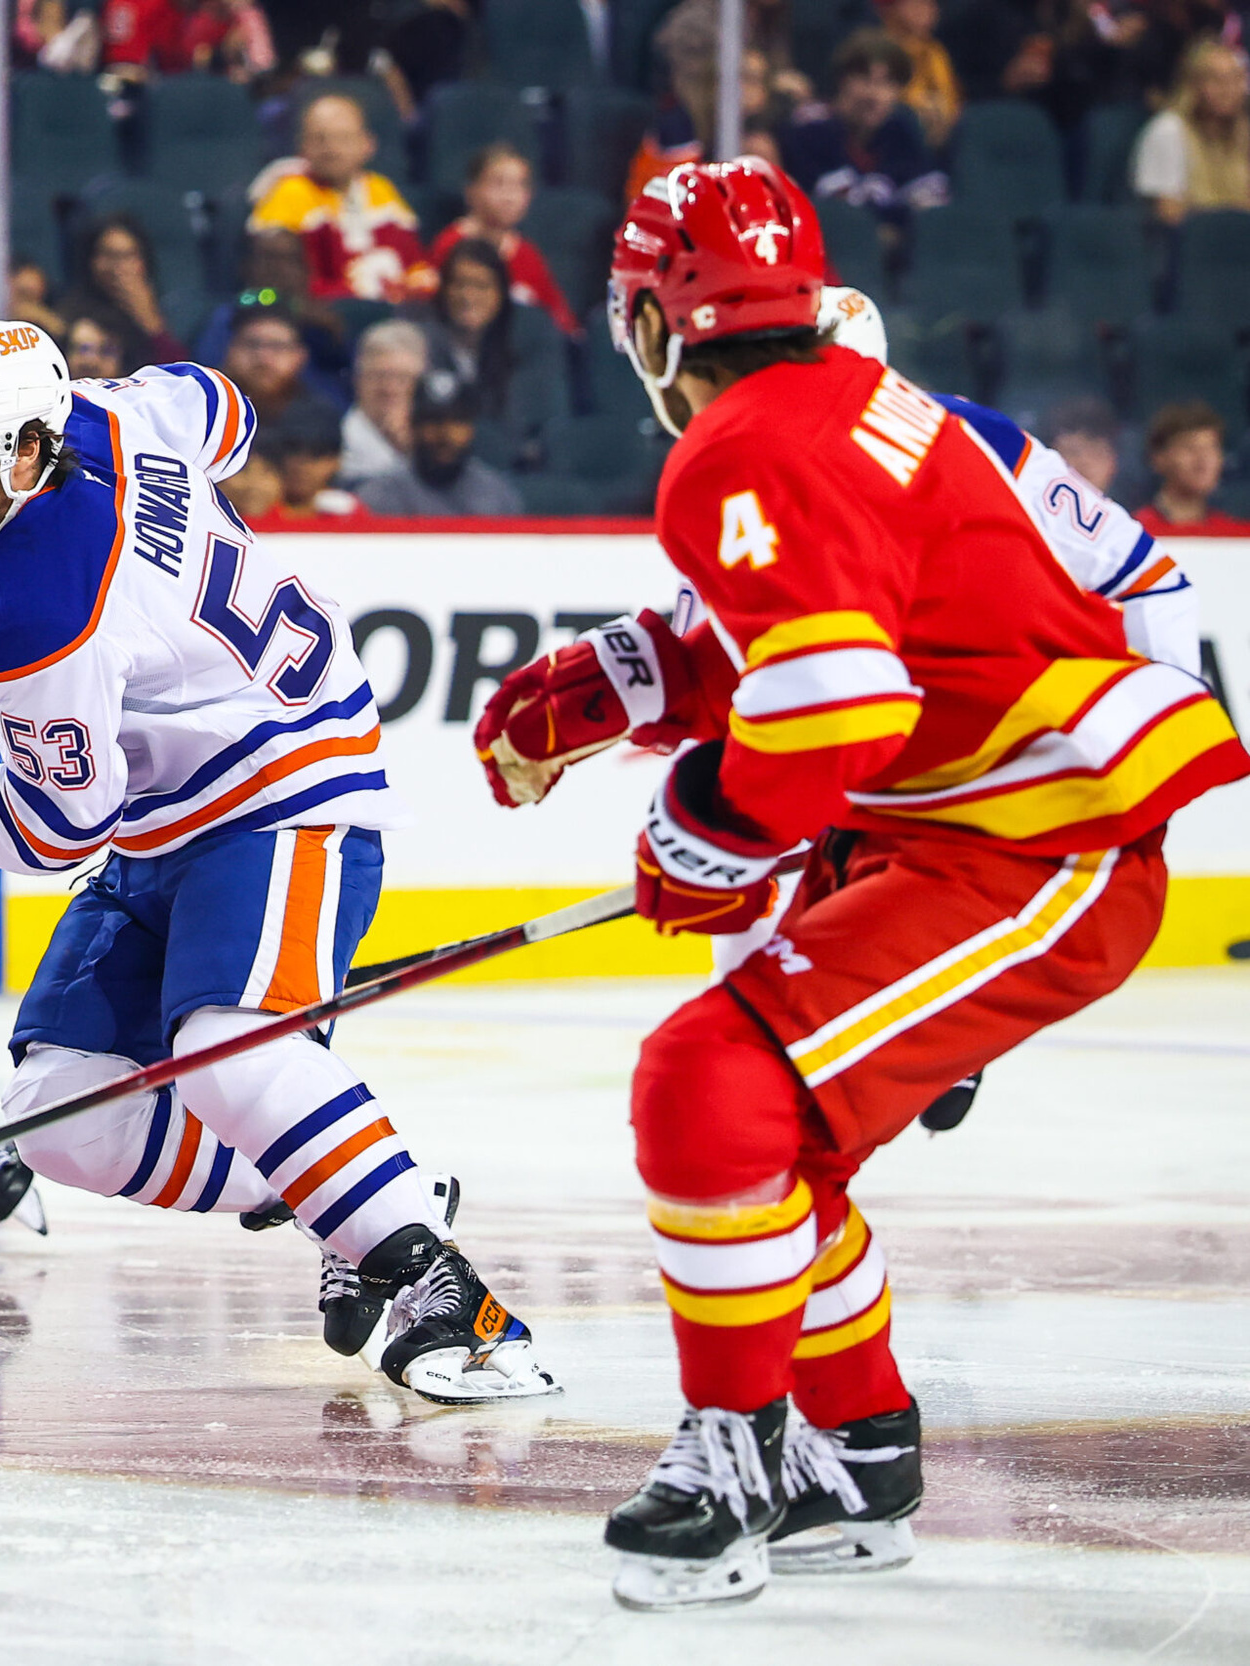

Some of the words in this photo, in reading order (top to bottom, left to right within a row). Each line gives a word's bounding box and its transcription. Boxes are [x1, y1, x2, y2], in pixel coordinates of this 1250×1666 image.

[134, 452, 192, 578] HOWARD
[717, 488, 781, 571] 4
[1043, 475, 1109, 542] 2
[0, 711, 96, 791] 53
[426, 1371, 451, 1382] CCM
